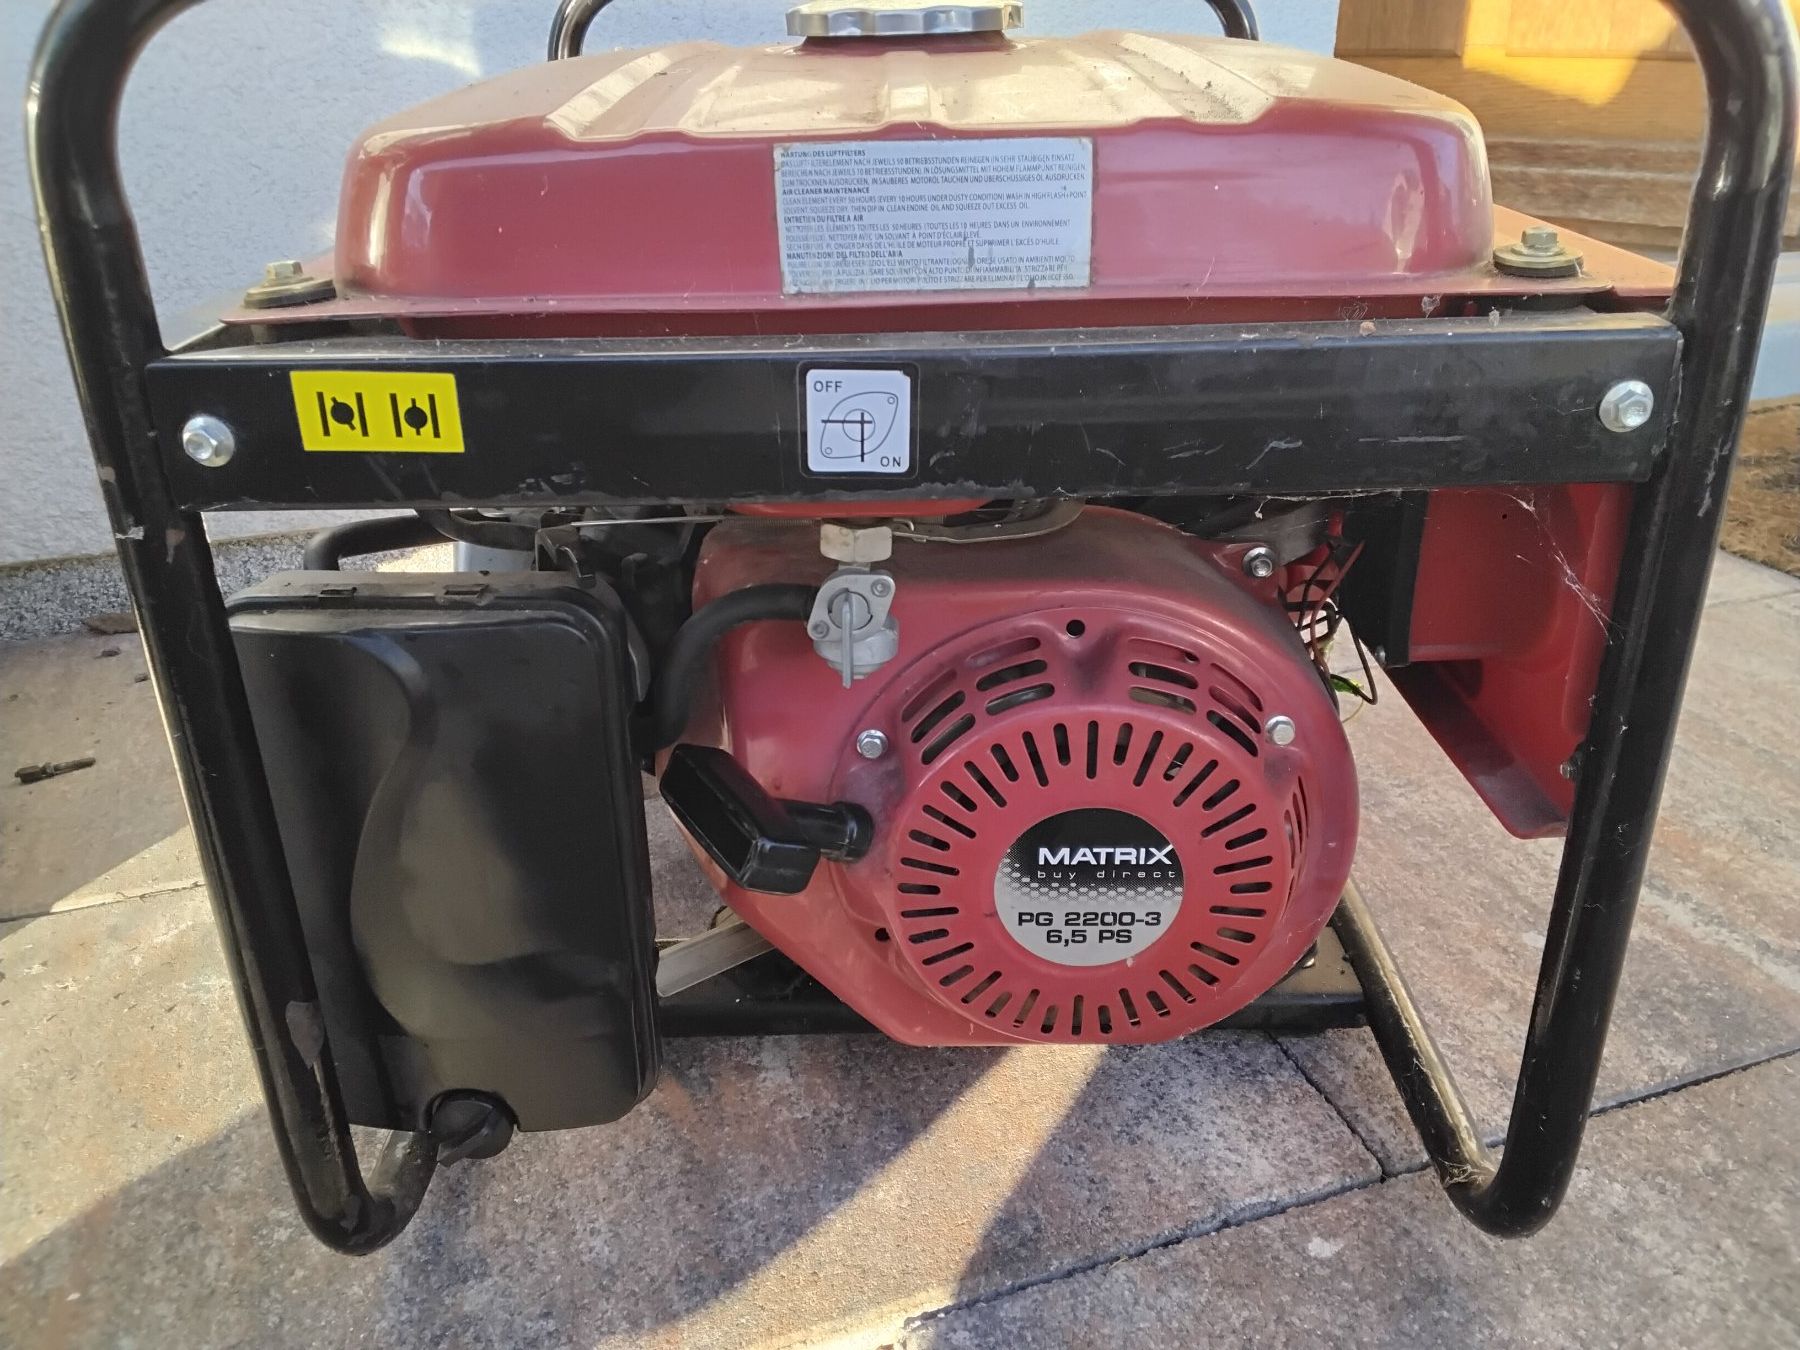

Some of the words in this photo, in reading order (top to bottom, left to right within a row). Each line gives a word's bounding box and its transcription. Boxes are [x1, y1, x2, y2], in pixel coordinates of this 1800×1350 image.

[928, 194, 947, 202] UNDER
[948, 193, 968, 201] DUSTY
[813, 380, 843, 393] OFF
[880, 456, 902, 468] ON
[1038, 844, 1174, 866] MATRIX
[1037, 870, 1076, 880] buy
[1096, 870, 1176, 879] direct
[1018, 911, 1054, 927] PG
[1064, 911, 1162, 927] 2200-3
[1046, 929, 1087, 947] 6,5
[1098, 929, 1133, 944] PS
